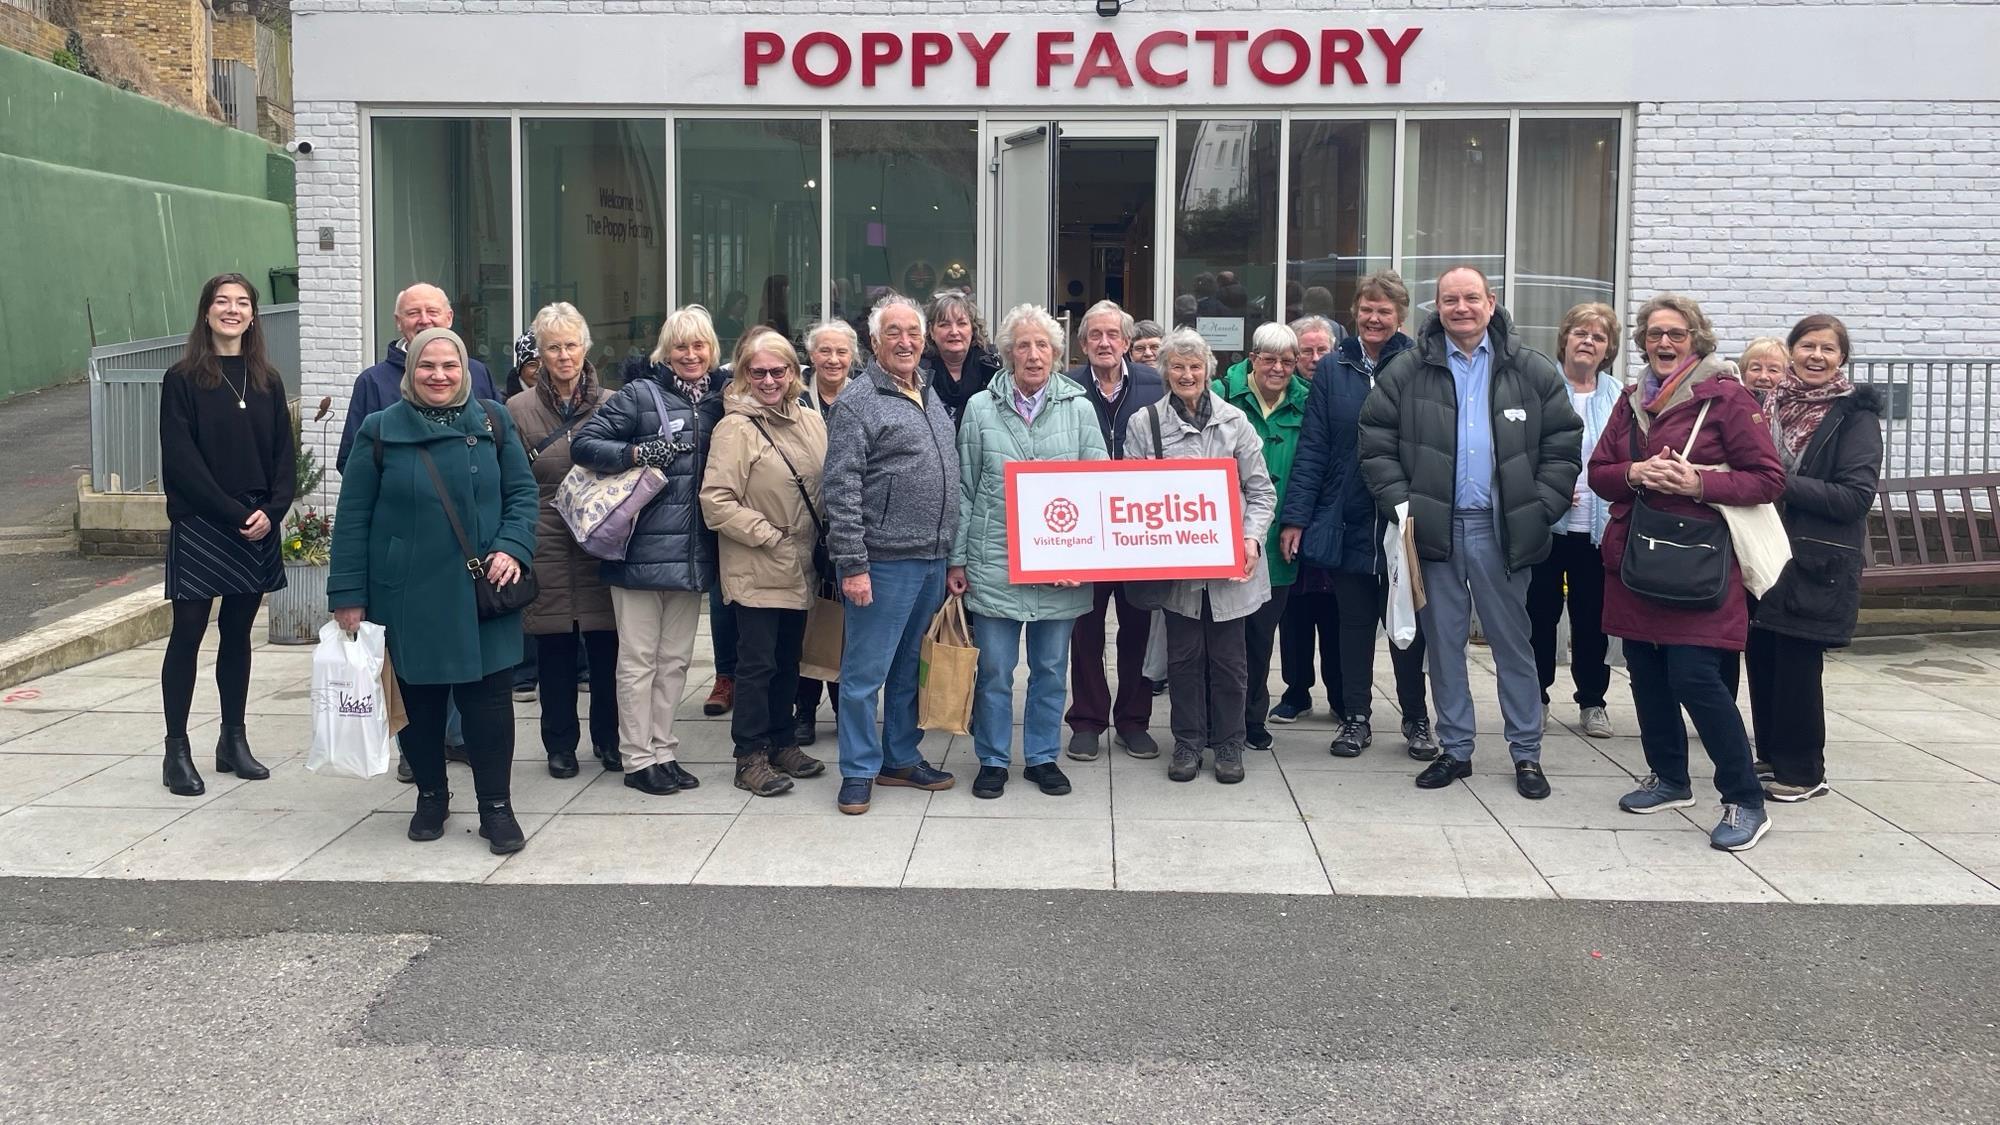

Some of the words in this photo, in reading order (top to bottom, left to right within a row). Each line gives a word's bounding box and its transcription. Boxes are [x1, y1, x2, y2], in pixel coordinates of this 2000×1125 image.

[743, 31, 1010, 88] POPPY
[1035, 27, 1423, 88] FACTORY
[599, 187, 634, 211] Welcome
[585, 214, 601, 236] The
[602, 215, 627, 243] Poppy
[628, 218, 653, 246] Factory
[1109, 493, 1218, 530] English
[1033, 535, 1094, 548] VisitEngland
[1112, 530, 1173, 547] Tourism
[1175, 528, 1219, 546] Week
